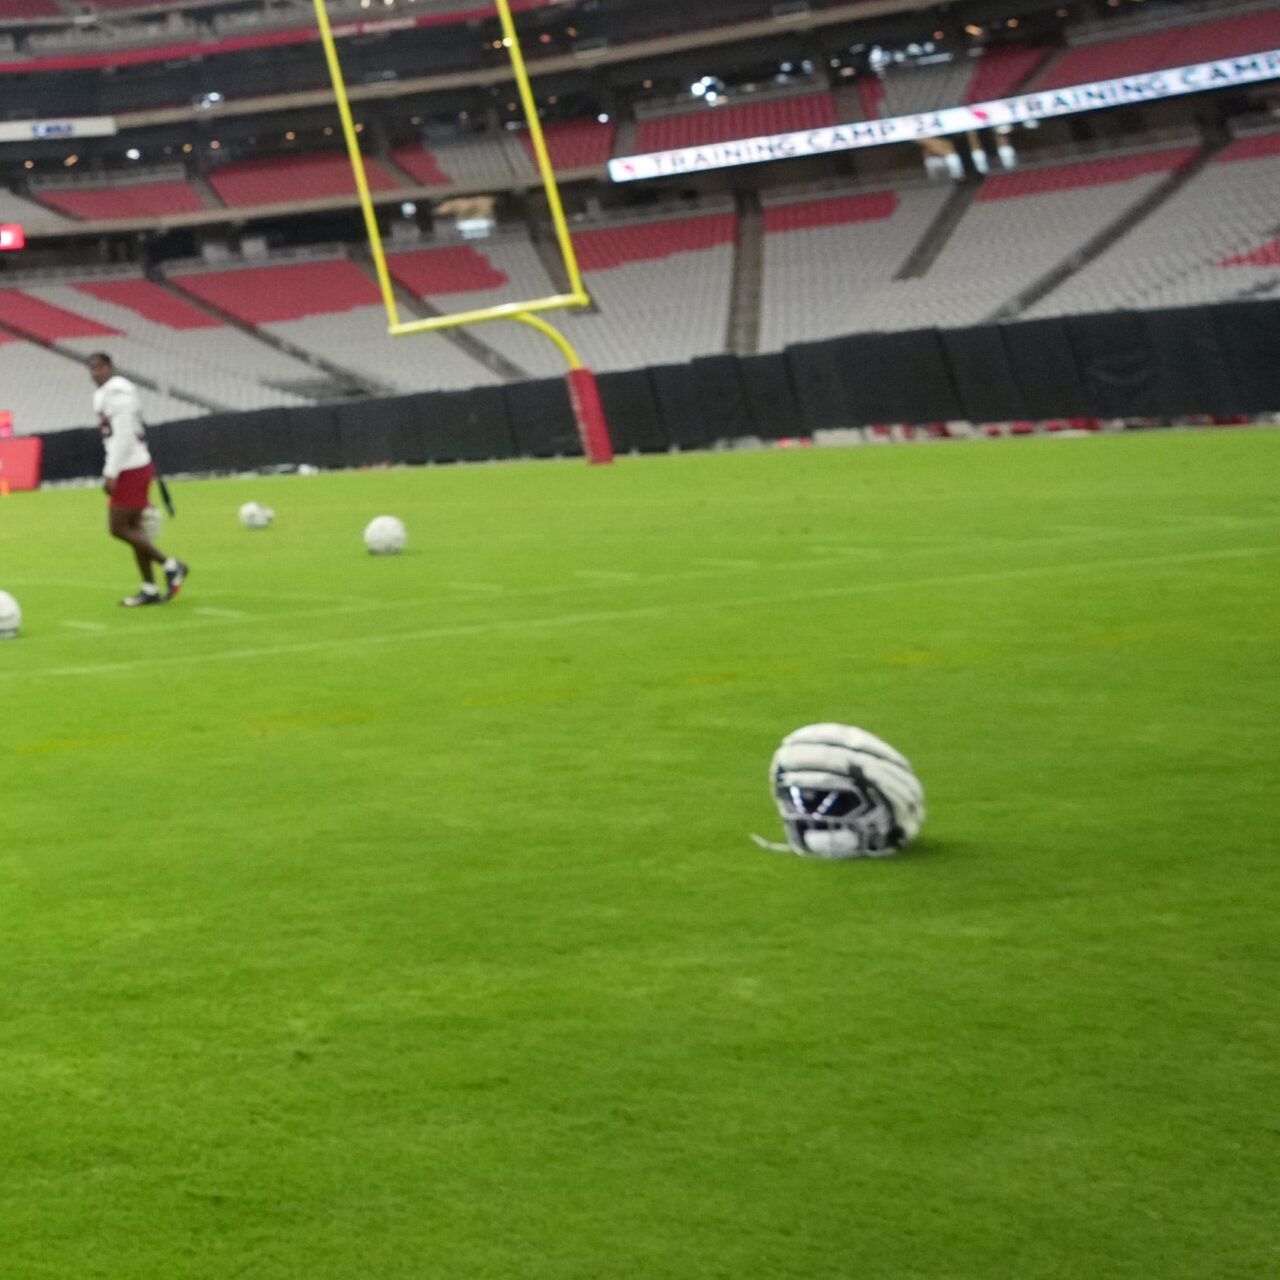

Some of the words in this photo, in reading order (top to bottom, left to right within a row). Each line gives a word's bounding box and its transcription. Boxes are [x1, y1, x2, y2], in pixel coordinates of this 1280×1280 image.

[1007, 76, 1168, 117] TRAINING
[653, 139, 796, 170] TRAINING
[807, 124, 896, 147] CAMP
